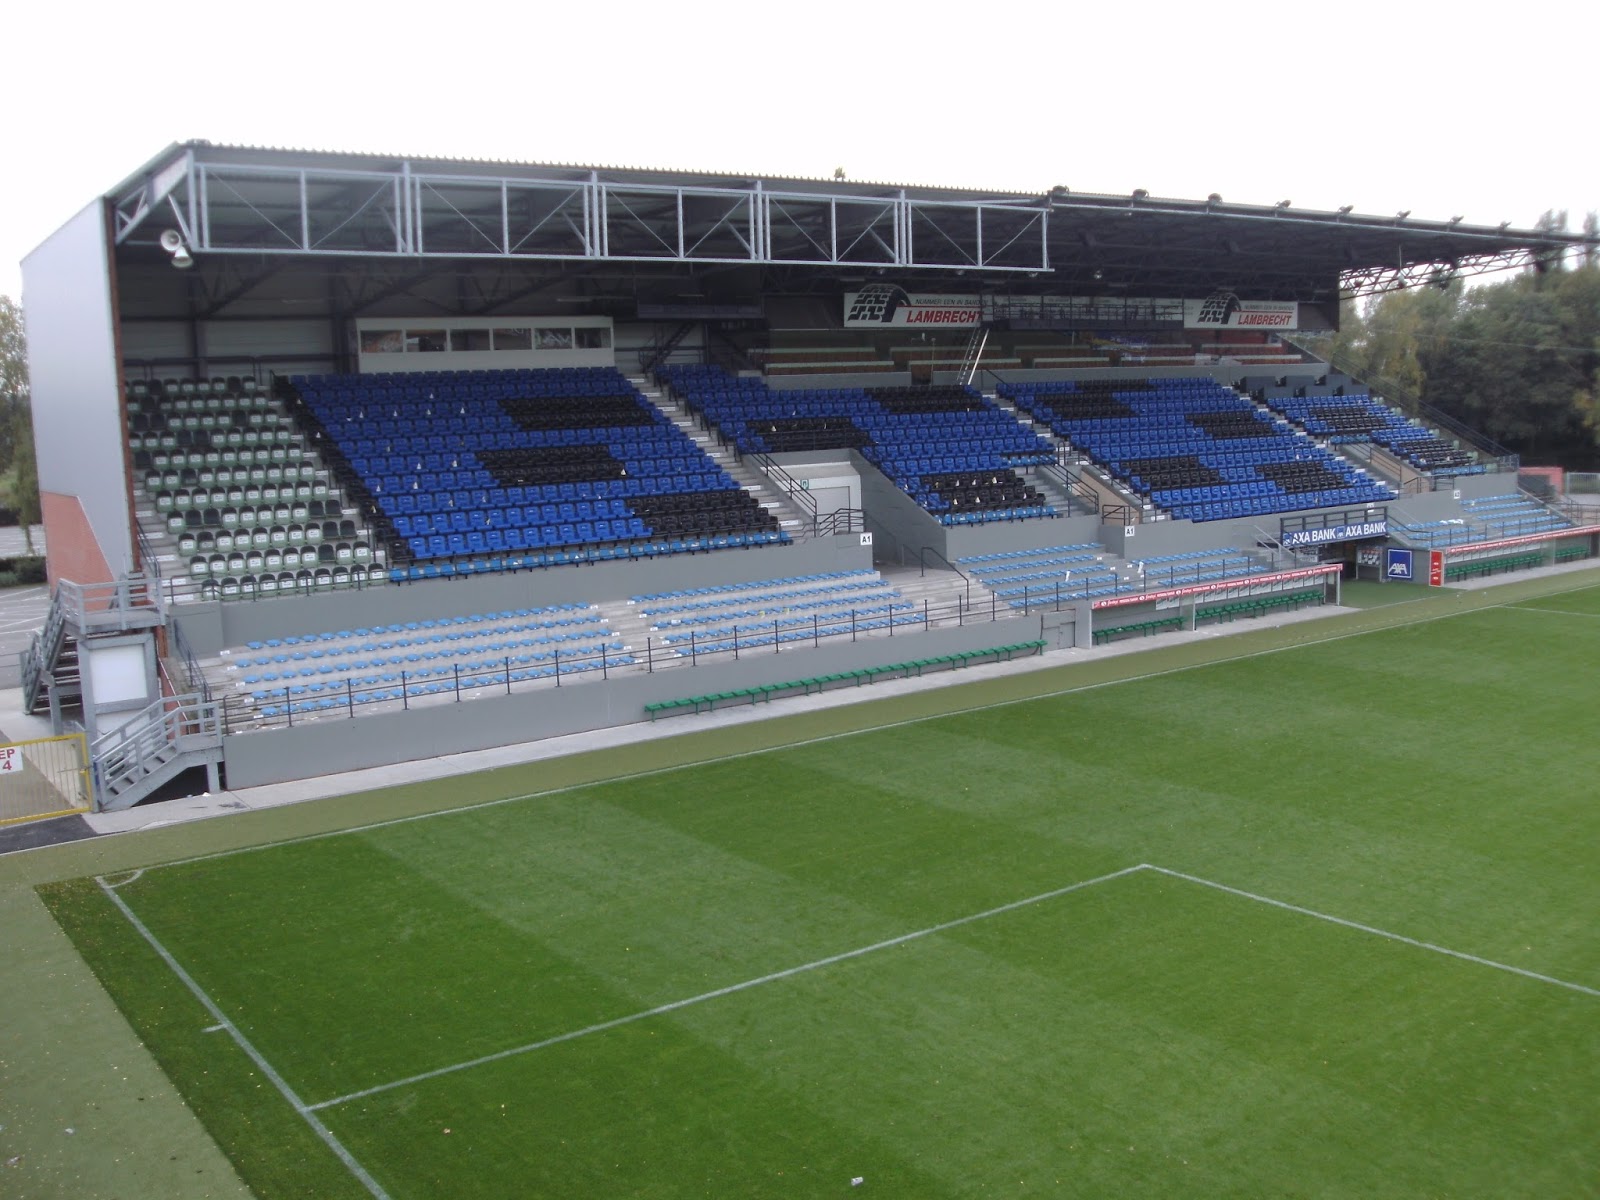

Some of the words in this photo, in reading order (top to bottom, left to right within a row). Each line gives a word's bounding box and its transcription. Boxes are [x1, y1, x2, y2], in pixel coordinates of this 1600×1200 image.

[906, 310, 984, 323] LAMBRECHT
[1238, 314, 1292, 326] LAMBRECHT
[1292, 532, 1311, 545] AXA
[1311, 527, 1337, 542] BANK
[1345, 525, 1363, 537] AXA
[1363, 521, 1387, 535] BANK
[1388, 562, 1408, 575] AXA
[2, 760, 12, 770] 4
